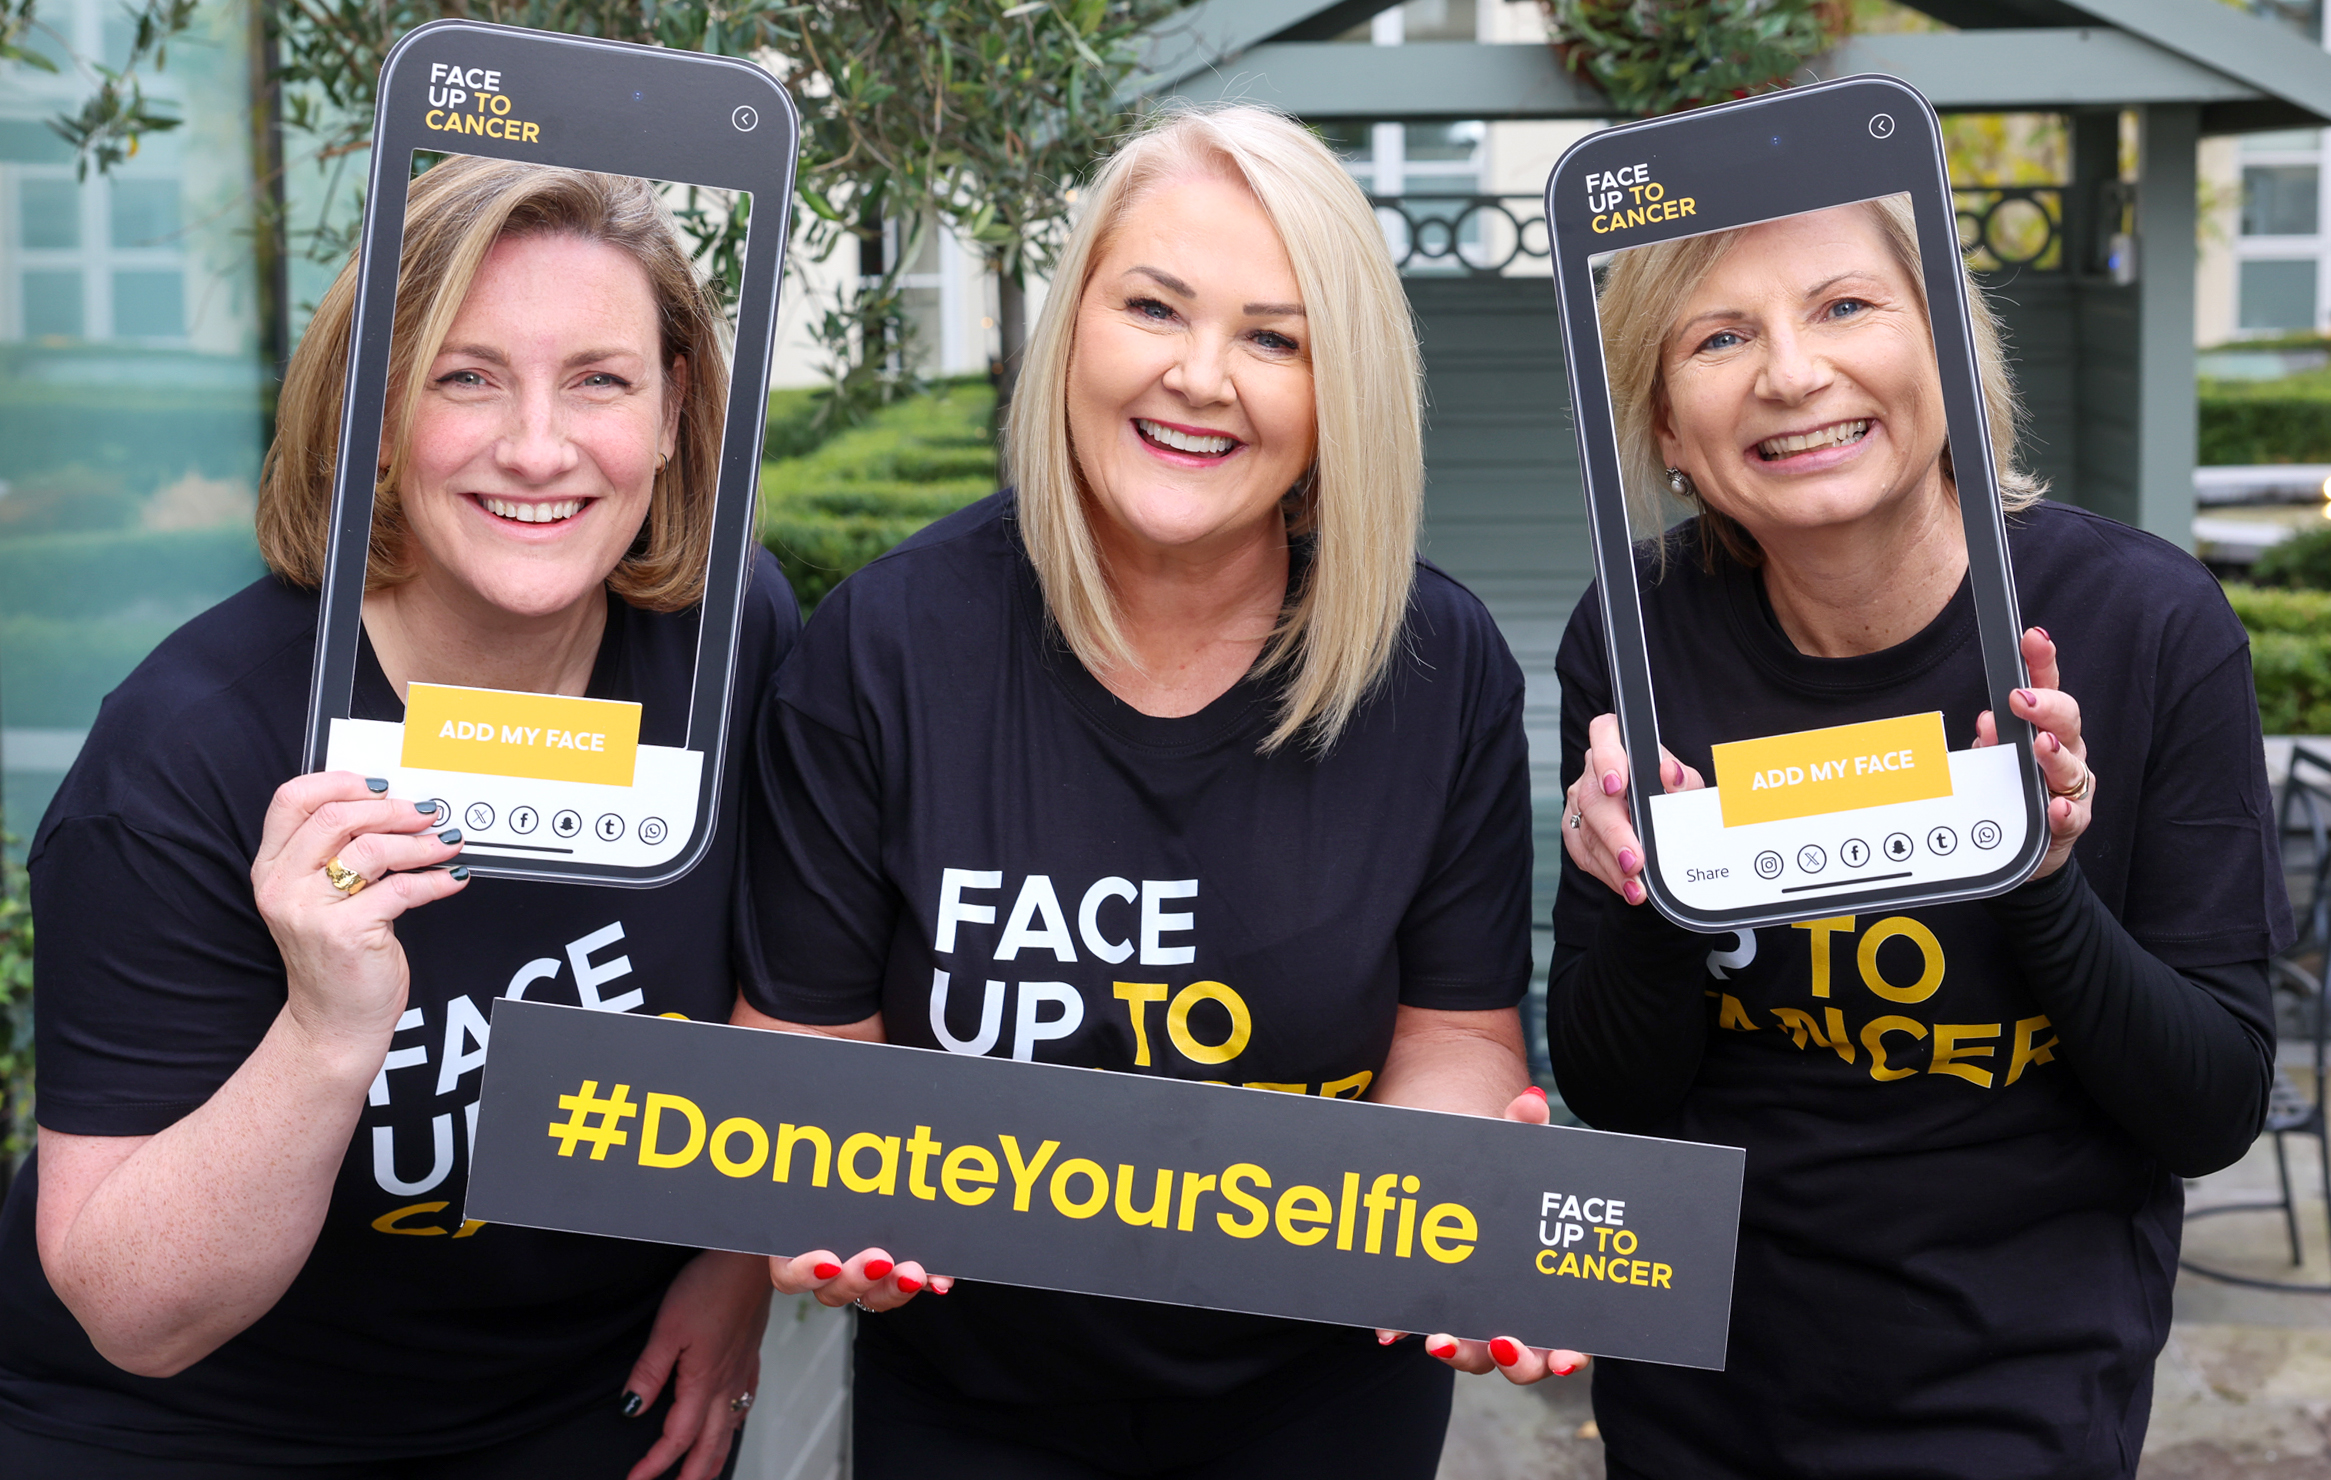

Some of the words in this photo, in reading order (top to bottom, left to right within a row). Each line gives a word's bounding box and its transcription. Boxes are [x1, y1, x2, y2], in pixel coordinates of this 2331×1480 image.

[430, 62, 502, 92] FACE
[428, 85, 467, 109] UP
[474, 91, 512, 116] TO
[425, 109, 541, 143] CANCER
[1585, 163, 1650, 193] FACE
[1588, 190, 1624, 214] UP
[1629, 182, 1665, 205] TO
[1591, 197, 1697, 234] CANCER
[438, 719, 495, 742] ADD
[500, 725, 541, 747] MY
[545, 728, 606, 752] FACE
[1751, 765, 1805, 791] ADD
[1810, 758, 1848, 783] MY
[1854, 749, 1916, 775] FACE
[1685, 864, 1730, 883] Share
[934, 867, 1199, 966] FACE
[1791, 915, 1946, 1004] TO
[929, 967, 1086, 1063] UP
[1113, 980, 1253, 1067] TO
[1703, 989, 2061, 1089] ANCER
[372, 1100, 480, 1196] U
[548, 1080, 1479, 1266] #DonateYourSelfie
[1541, 1191, 1626, 1226] FACE
[1539, 1219, 1584, 1248] UP
[1593, 1226, 1638, 1255] TO
[1535, 1249, 1673, 1289] CANCER
